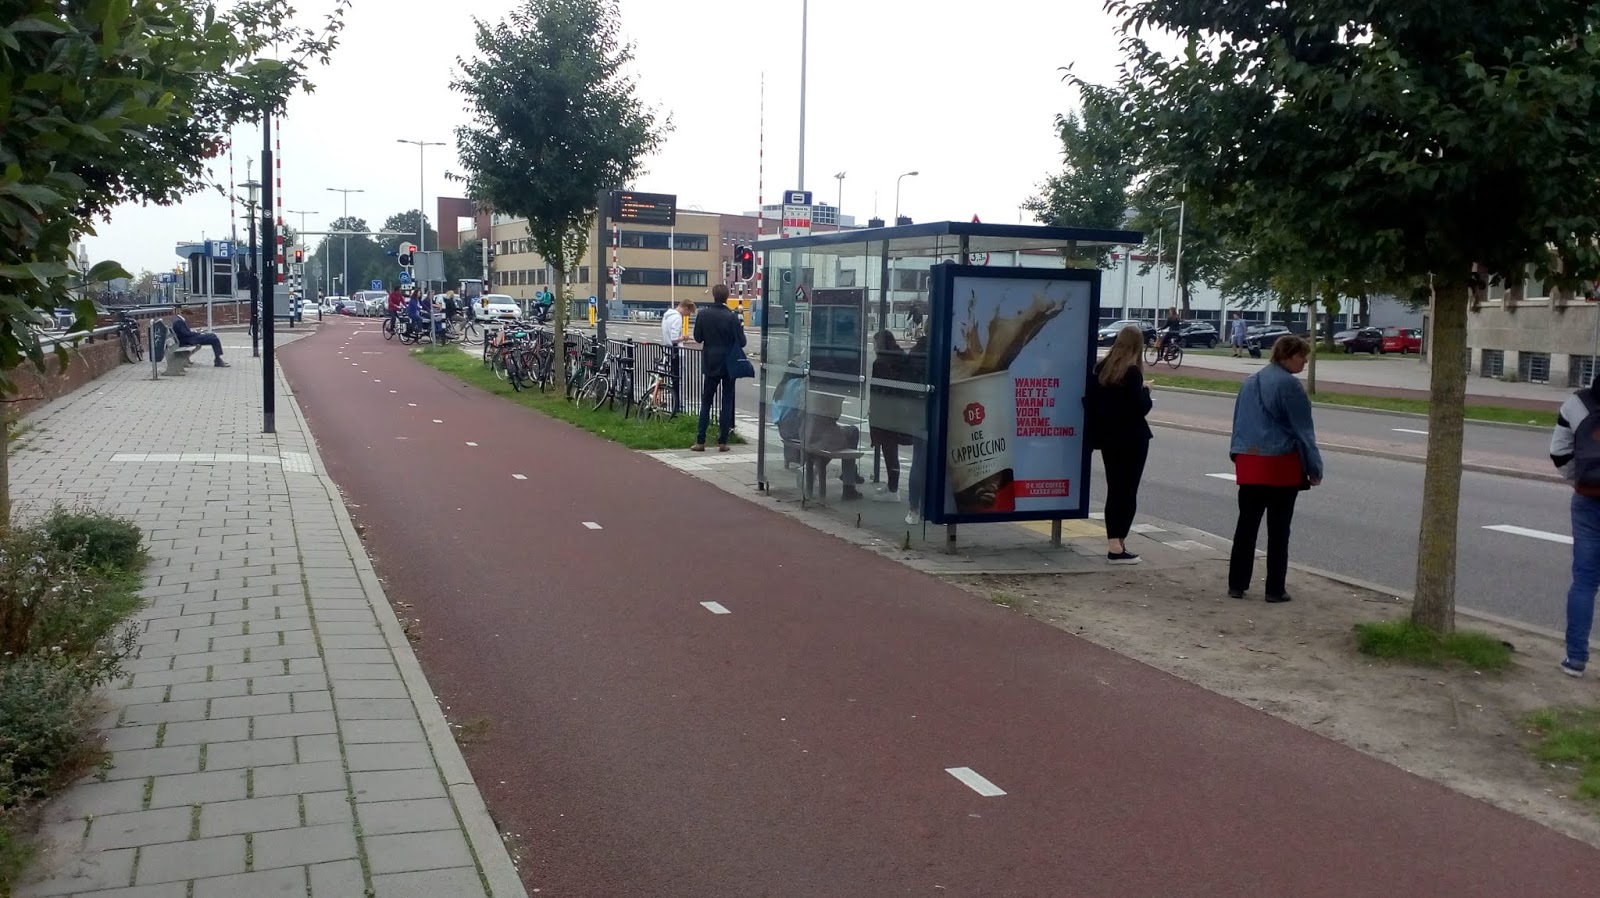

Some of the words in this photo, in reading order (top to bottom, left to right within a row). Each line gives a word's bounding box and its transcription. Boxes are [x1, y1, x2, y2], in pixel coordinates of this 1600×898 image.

[1015, 378, 1059, 387] WANNEER
[1016, 388, 1033, 397] HET
[1036, 388, 1047, 397] TE
[1016, 398, 1043, 407] WARM
[1046, 398, 1055, 407] IS
[1016, 408, 1039, 416] VOOR
[1016, 418, 1050, 426] WARME
[971, 430, 983, 440] ICE
[1017, 427, 1076, 436] CAPPUCCINO.
[952, 438, 1005, 463] CAPPUCCINO
